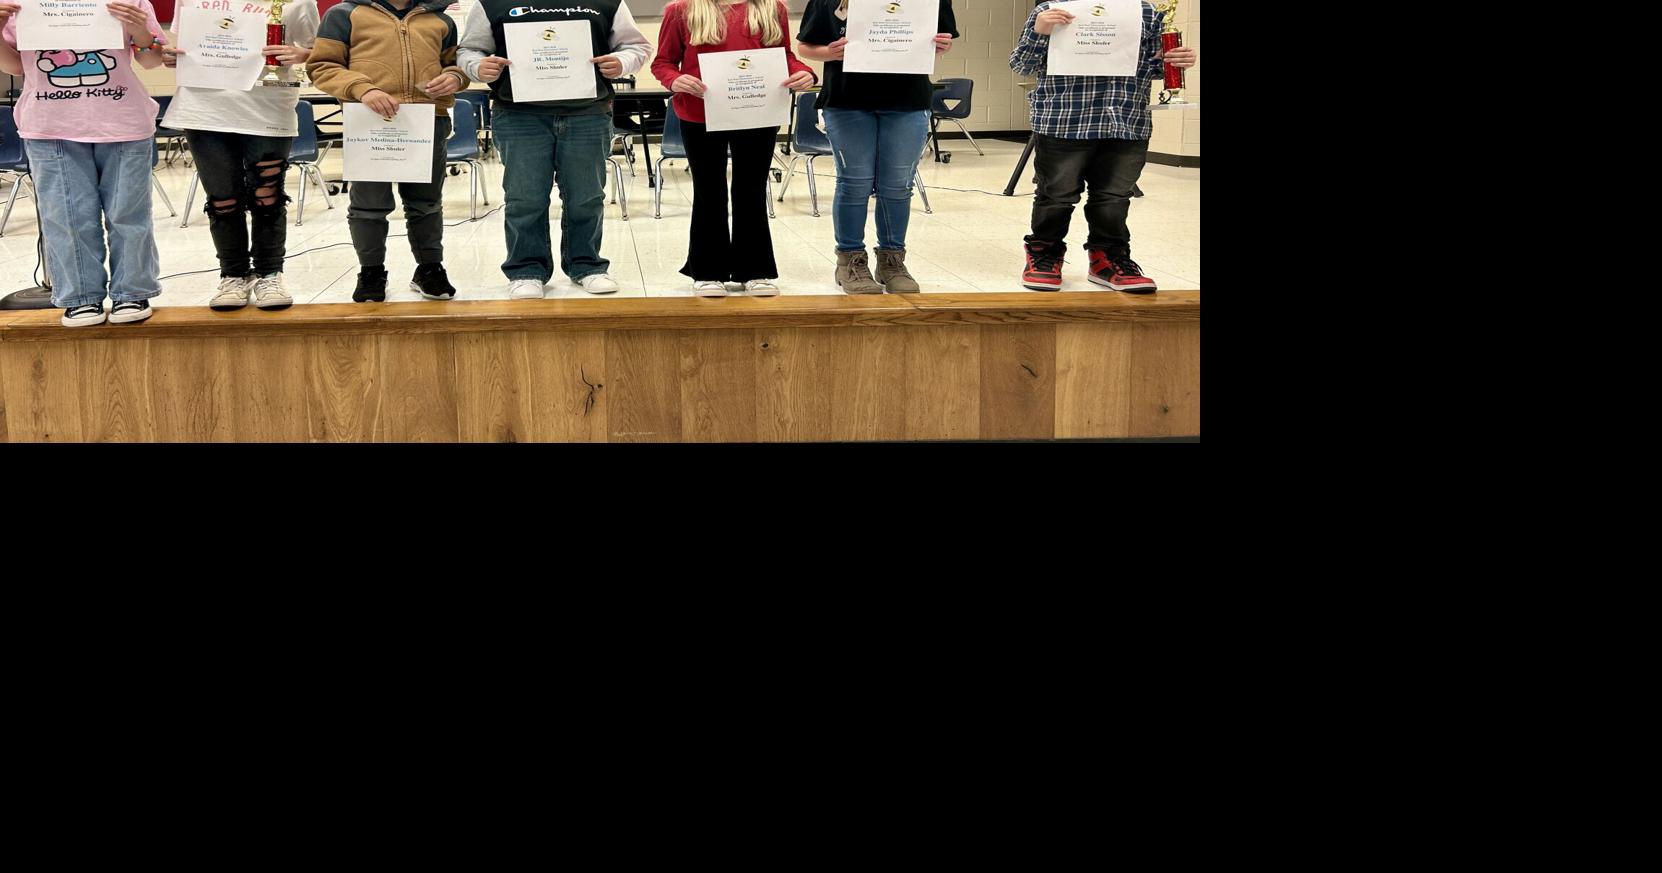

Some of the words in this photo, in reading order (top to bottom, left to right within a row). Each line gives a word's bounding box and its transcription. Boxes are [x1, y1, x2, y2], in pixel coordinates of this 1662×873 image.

[509, 6, 600, 16] Champion
[35, 90, 82, 100] Hello
[86, 88, 125, 100] Kitty
